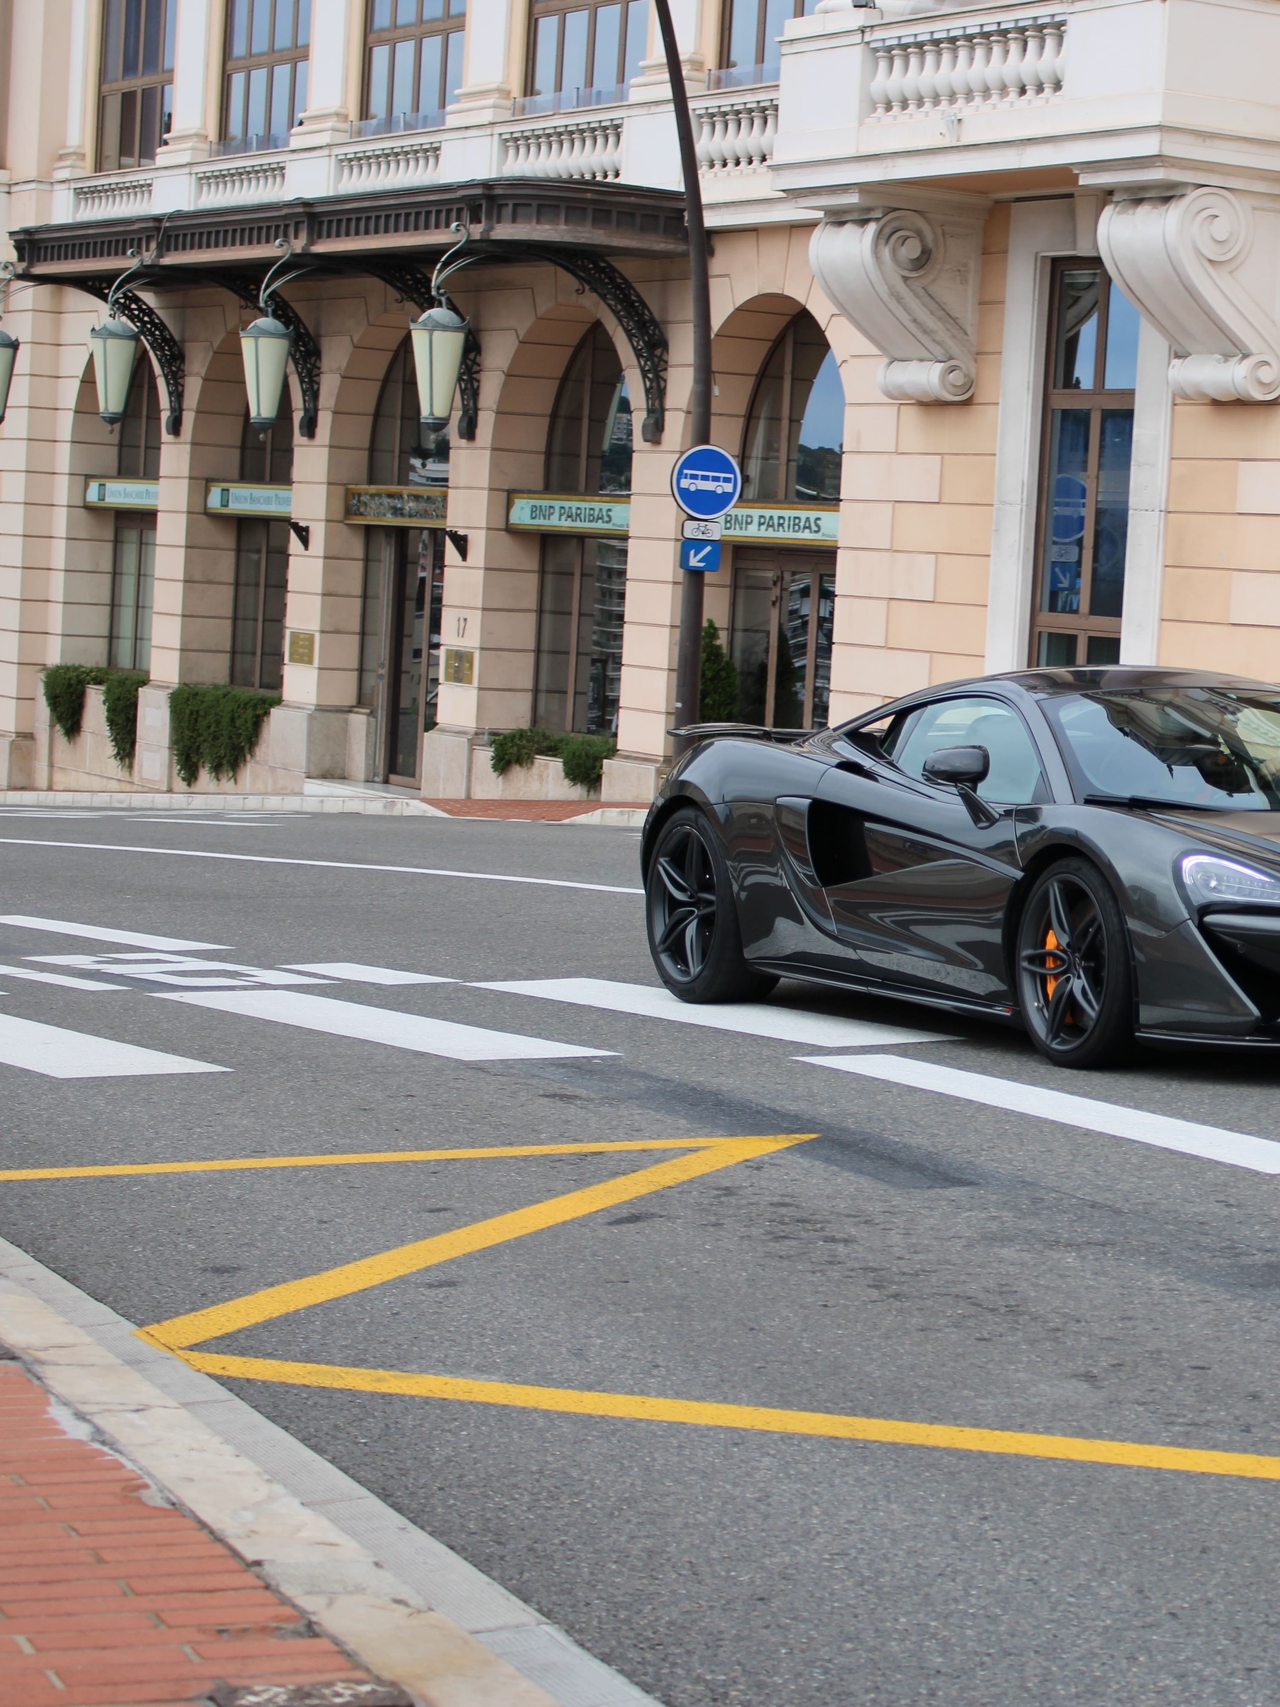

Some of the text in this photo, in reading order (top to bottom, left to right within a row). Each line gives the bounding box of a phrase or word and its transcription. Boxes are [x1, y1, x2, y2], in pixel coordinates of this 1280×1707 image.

[530, 504, 613, 524] BNP PARIBAS
[724, 513, 822, 534] BNP PARIBAS
[457, 617, 468, 638] 17
